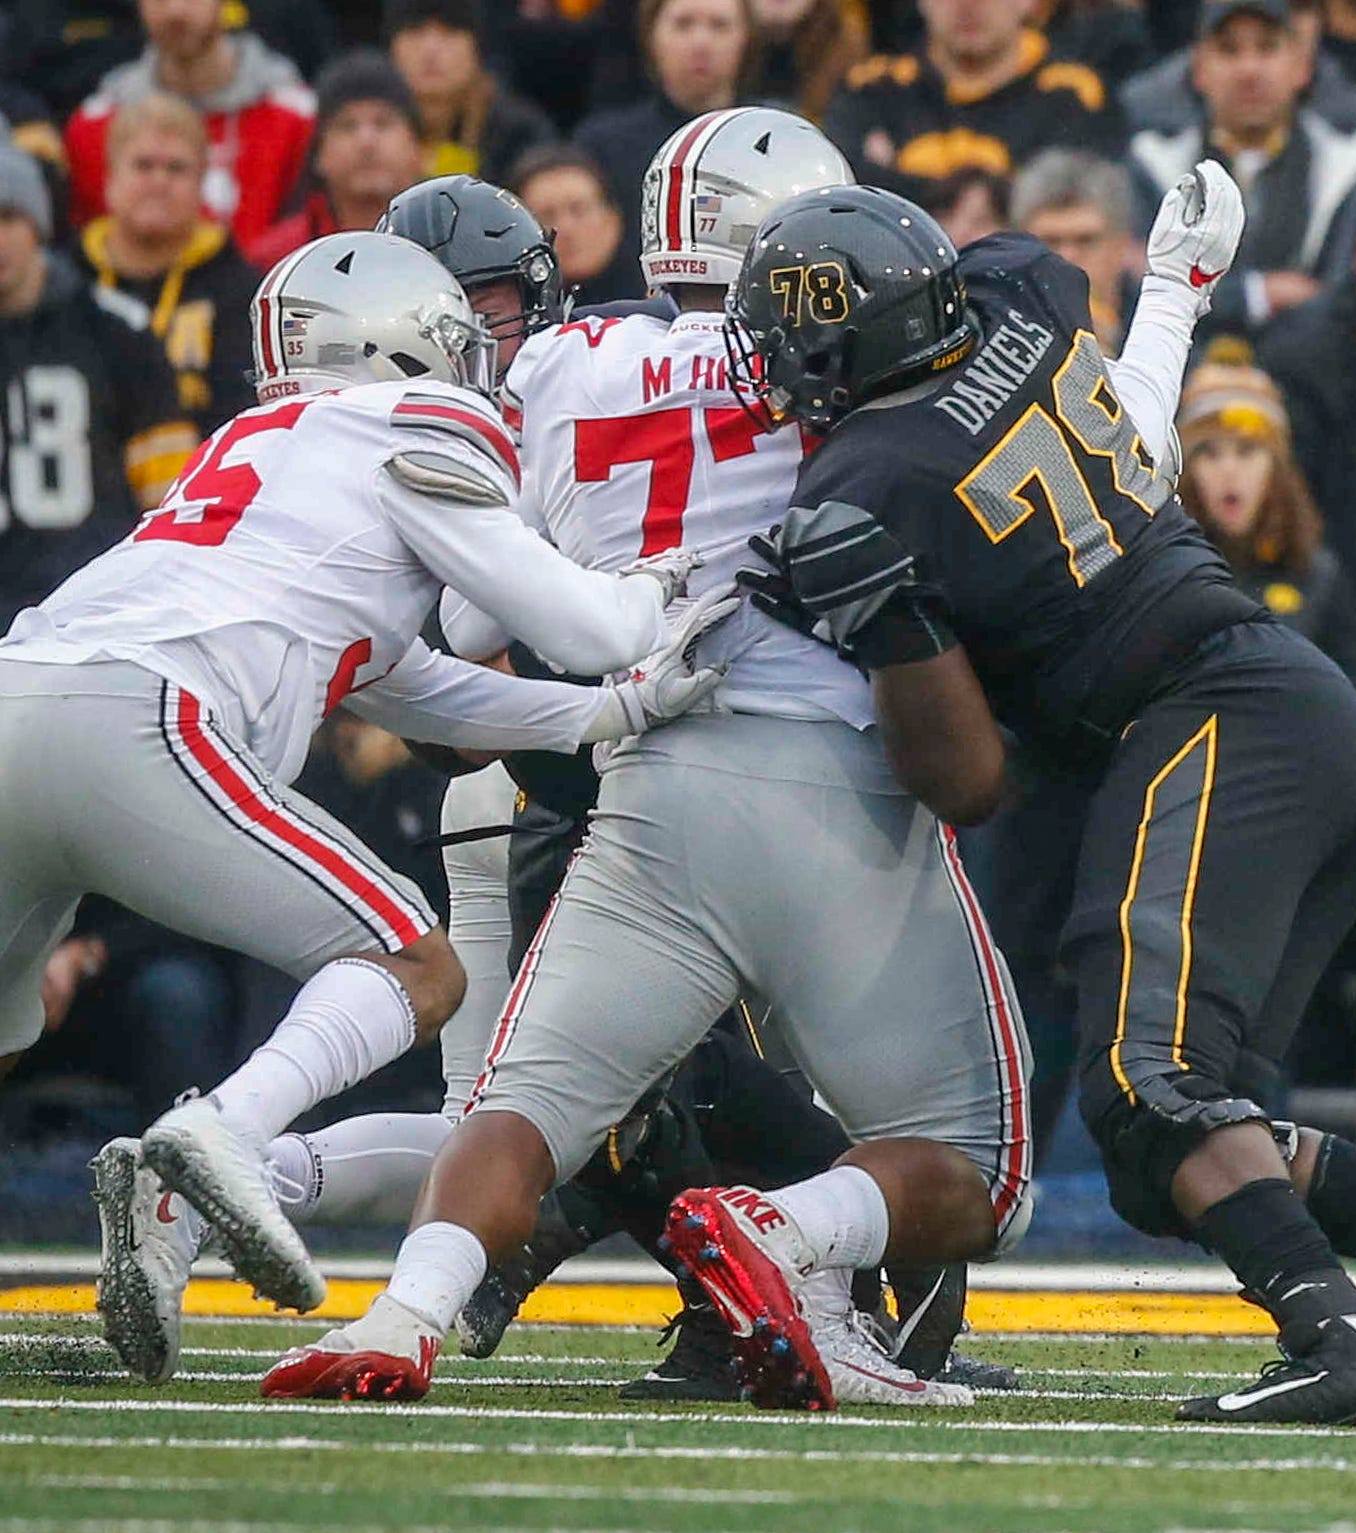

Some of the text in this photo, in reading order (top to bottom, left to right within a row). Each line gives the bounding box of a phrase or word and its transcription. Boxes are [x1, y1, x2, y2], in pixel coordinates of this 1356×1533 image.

[699, 217, 718, 233] 77
[769, 261, 849, 328] 78
[287, 340, 304, 356] 35
[933, 308, 1055, 436] DANIELS
[642, 355, 672, 405] M
[0, 364, 94, 530] 8
